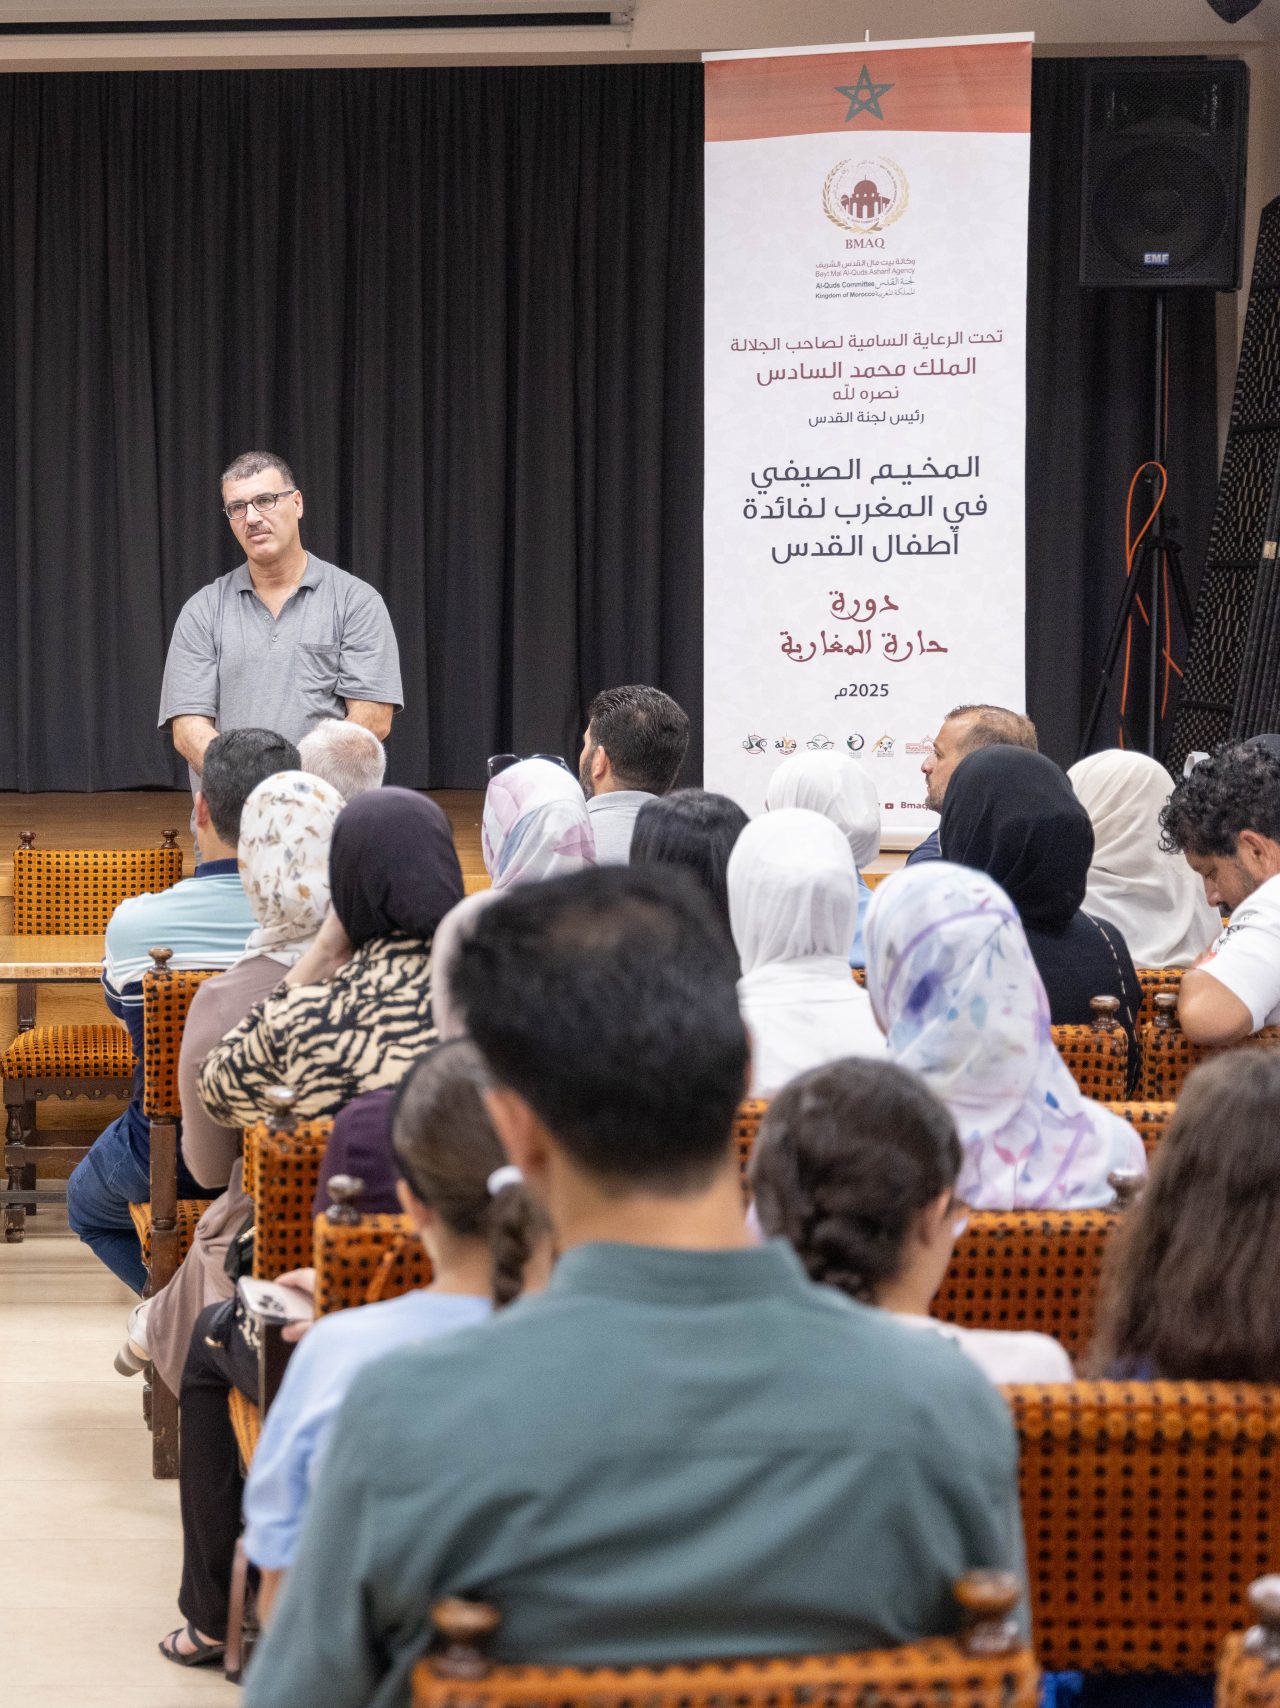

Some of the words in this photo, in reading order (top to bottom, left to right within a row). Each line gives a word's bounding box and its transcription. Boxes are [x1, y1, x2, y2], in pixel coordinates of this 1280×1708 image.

[845, 238, 886, 250] BMAQ
[842, 260, 865, 269] القدس
[1144, 253, 1169, 264] EMF
[816, 292, 842, 300] Kingdom
[731, 338, 780, 354] الجلالة
[786, 336, 844, 354] لصاحب
[848, 333, 908, 352] السامية
[913, 331, 963, 352] الرعاية
[968, 329, 1003, 345] تحت
[756, 361, 842, 386] السادس
[850, 363, 906, 378] محمد
[913, 357, 976, 377] الملك
[860, 386, 899, 404] نصره
[808, 412, 853, 428] القدس
[857, 410, 886, 426] لجنة
[889, 410, 925, 426] رئيس
[751, 458, 861, 495] الصيفي
[870, 456, 980, 486] المخيم
[742, 496, 826, 520] لفائدة
[834, 495, 933, 525] المغرب
[942, 494, 988, 531] في
[772, 534, 863, 564] القدس
[872, 528, 959, 563] أطفال
[829, 590, 900, 622] دورة
[780, 629, 872, 663] المغاربة
[882, 630, 948, 662] حارة
